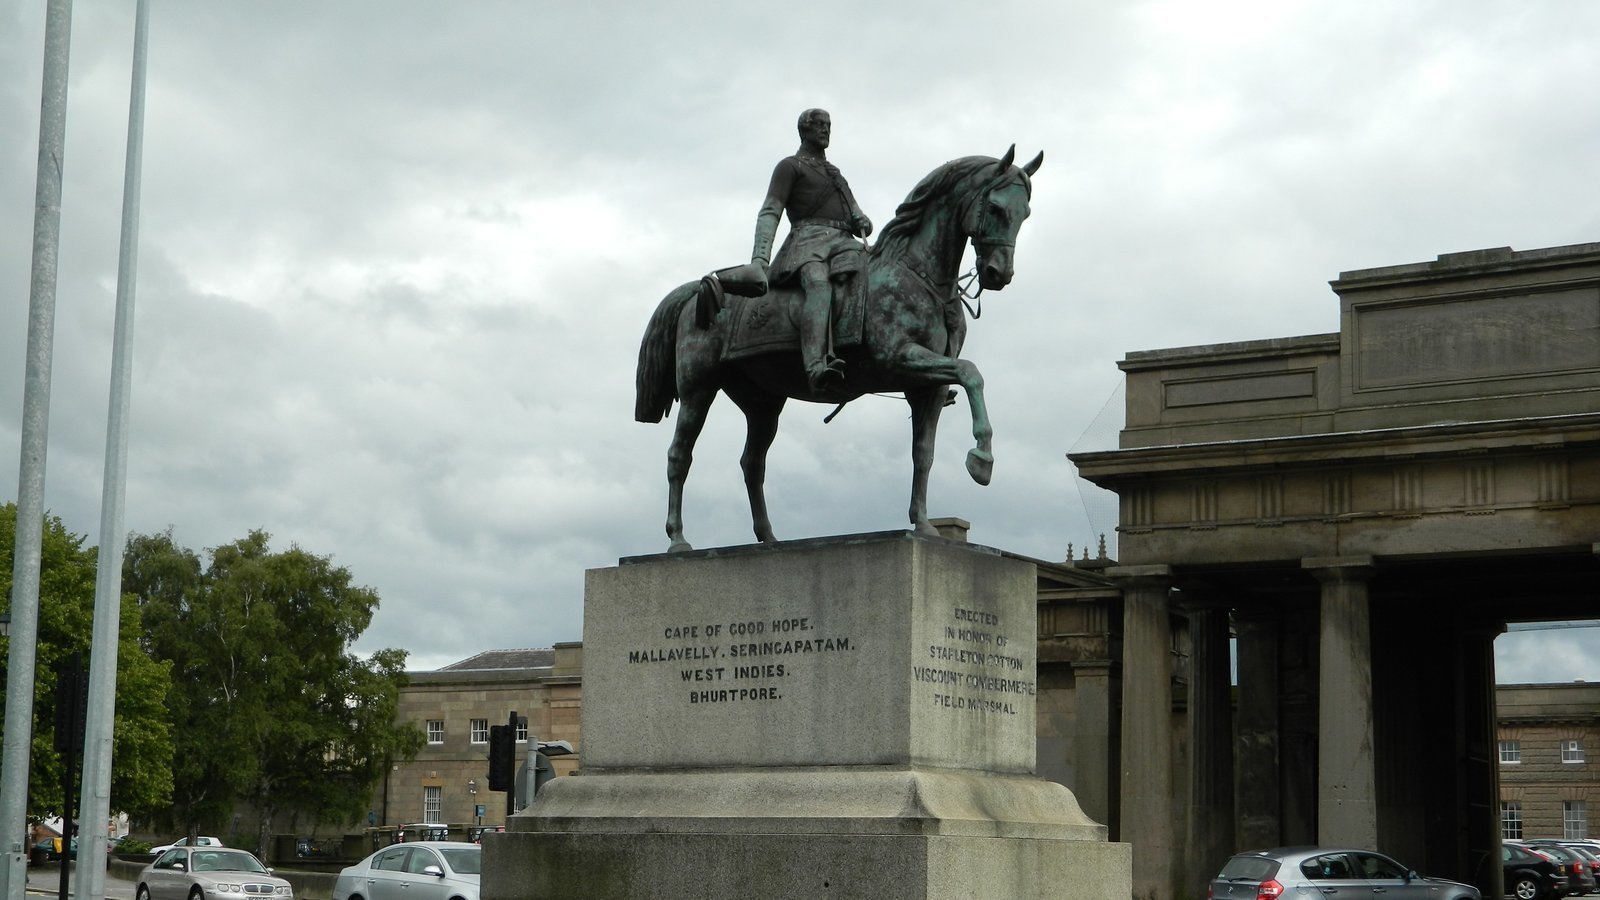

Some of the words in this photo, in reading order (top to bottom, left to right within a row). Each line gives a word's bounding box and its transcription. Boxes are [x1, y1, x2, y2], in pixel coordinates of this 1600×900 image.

[954, 608, 998, 626] ERECTED
[664, 626, 698, 639] CAPE
[706, 624, 722, 637] OF
[729, 622, 765, 636] GOOD
[772, 618, 814, 633] HOPE.
[945, 626, 955, 639] IN
[959, 629, 992, 644] HONOR
[997, 635, 1008, 647] OF
[681, 667, 725, 681] WEST
[734, 664, 790, 679] INDIES.
[914, 666, 964, 687] VISCOUNT
[690, 687, 783, 704] BHURTPORE.
[934, 693, 965, 709] FIELD
